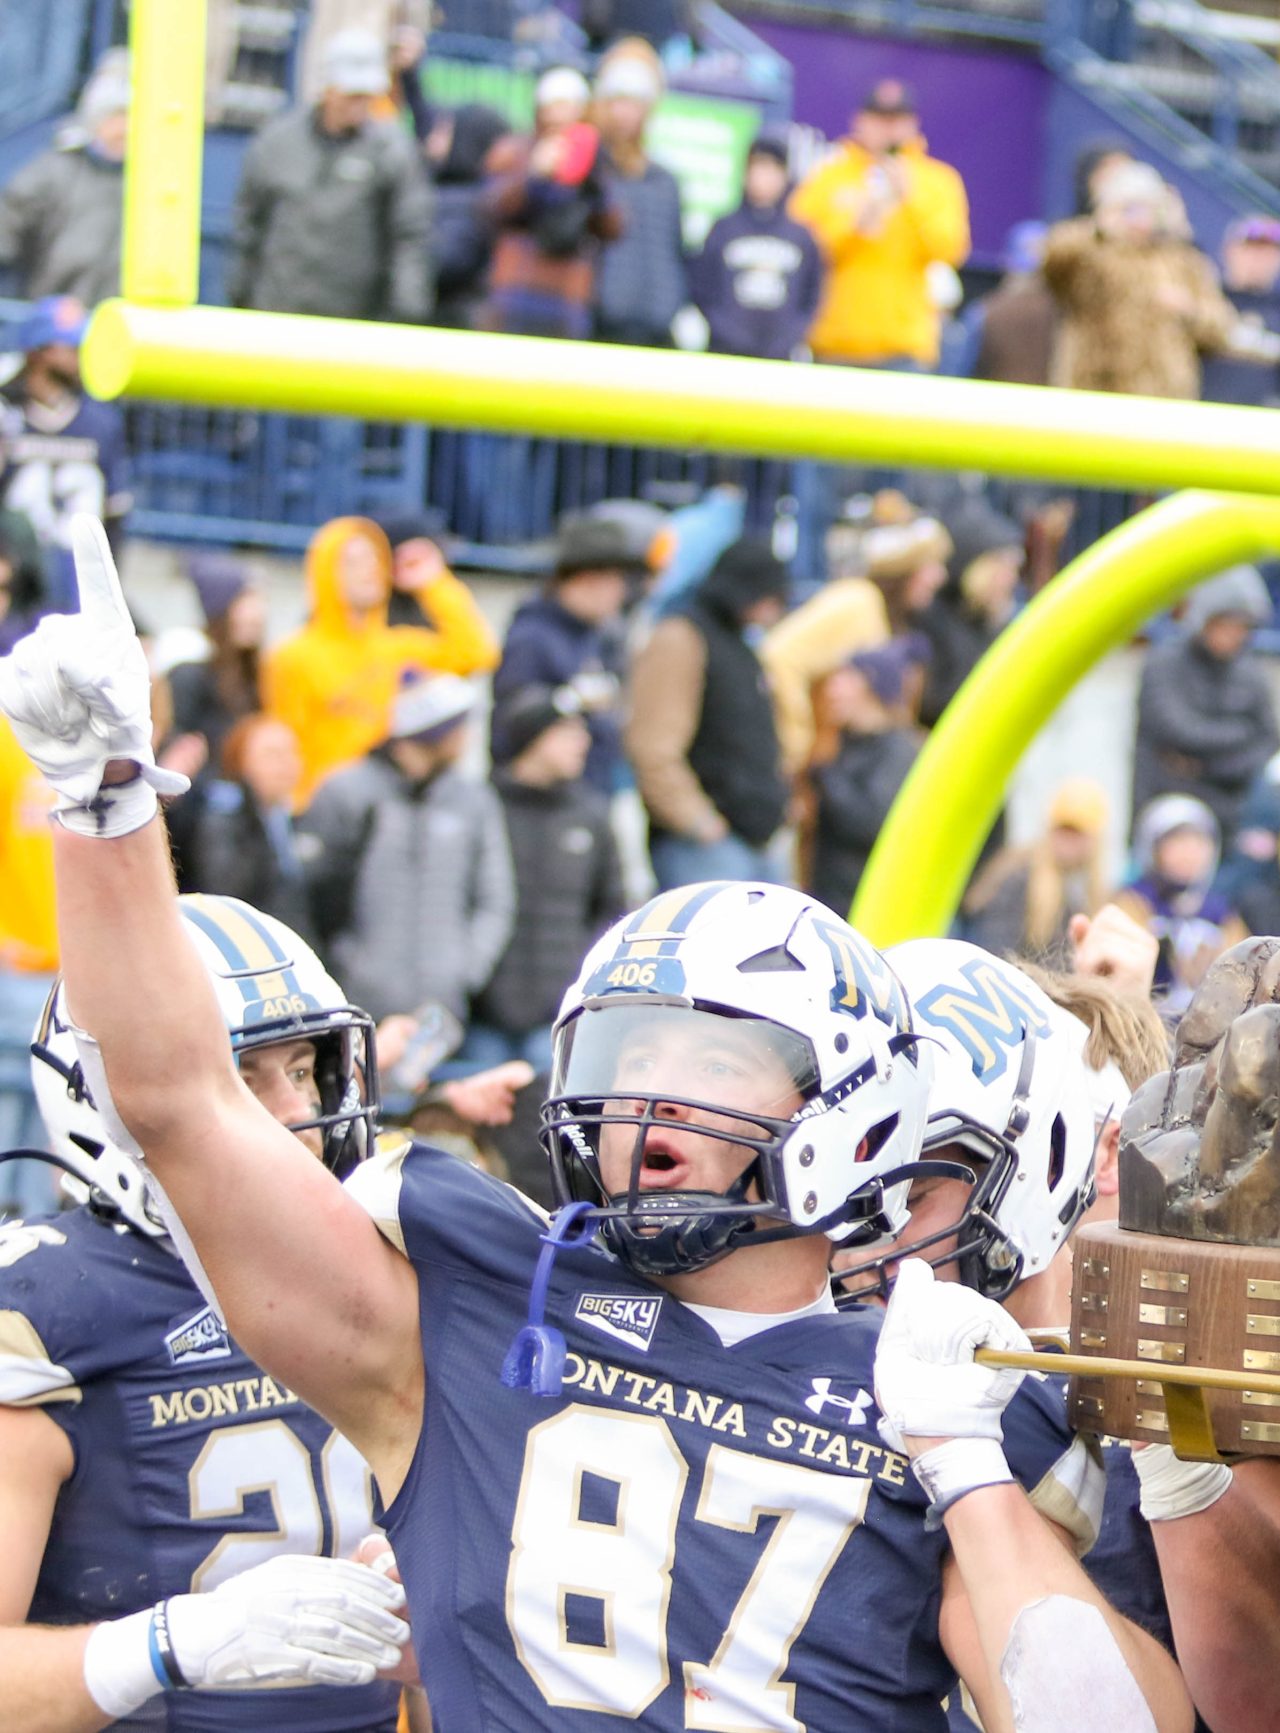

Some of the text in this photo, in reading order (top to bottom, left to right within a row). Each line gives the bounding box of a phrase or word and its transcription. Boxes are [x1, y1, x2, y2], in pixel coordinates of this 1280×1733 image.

[262, 995, 307, 1018] 406
[607, 962, 657, 986] 406
[914, 959, 1054, 1087] M
[149, 1375, 299, 1428] MONTA
[534, 1352, 747, 1438] ONTANA
[767, 1416, 911, 1487] STATE
[505, 1402, 873, 1733] 87
